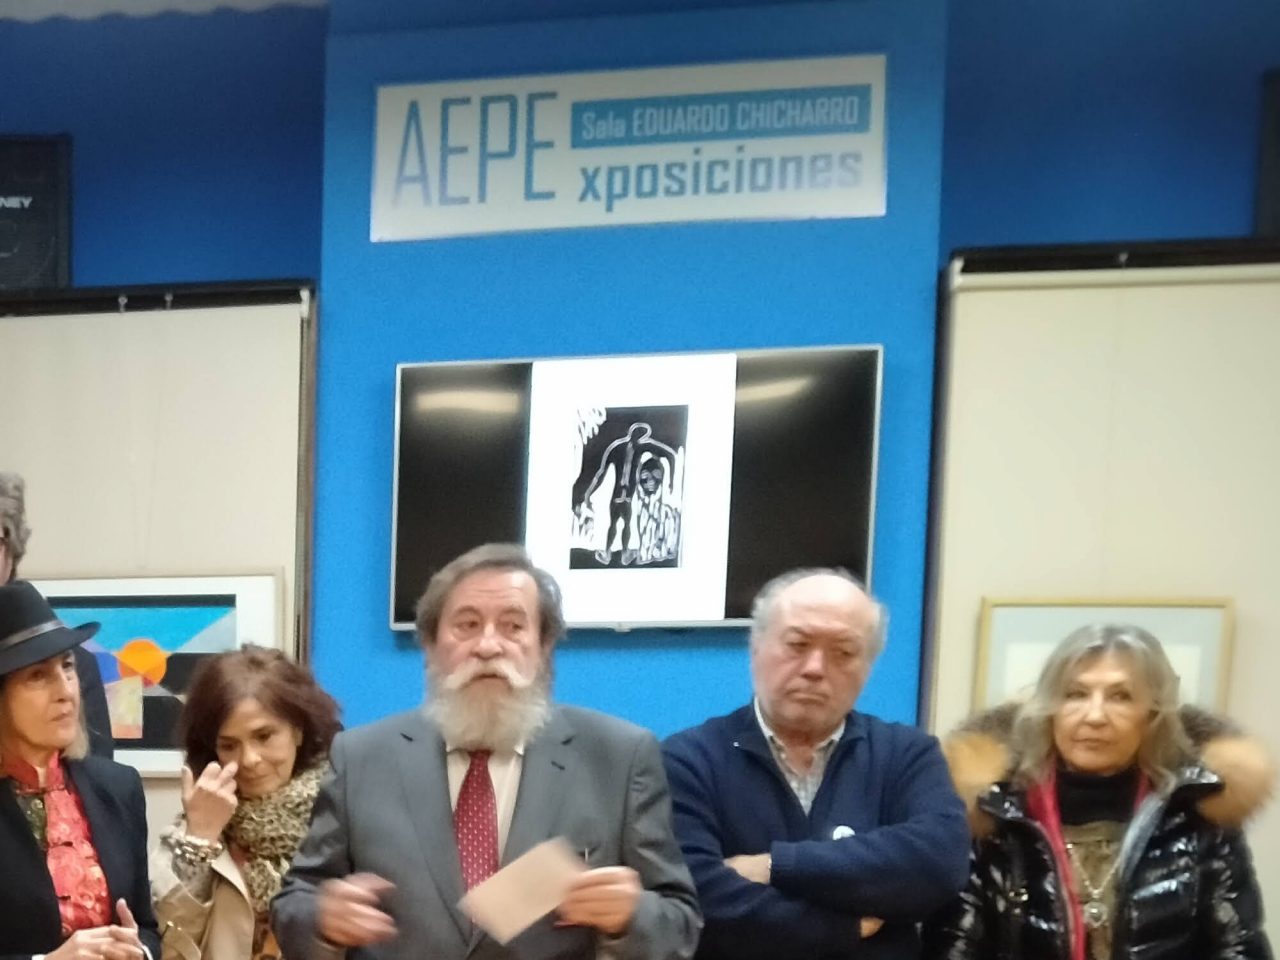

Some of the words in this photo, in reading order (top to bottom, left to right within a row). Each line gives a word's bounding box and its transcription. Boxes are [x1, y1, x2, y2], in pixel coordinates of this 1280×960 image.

[394, 92, 558, 206] AEPE
[581, 111, 626, 139] Sala
[632, 102, 728, 136] EDUARDO
[736, 95, 859, 130] CHICHARRO
[579, 145, 861, 212] xposiciones
